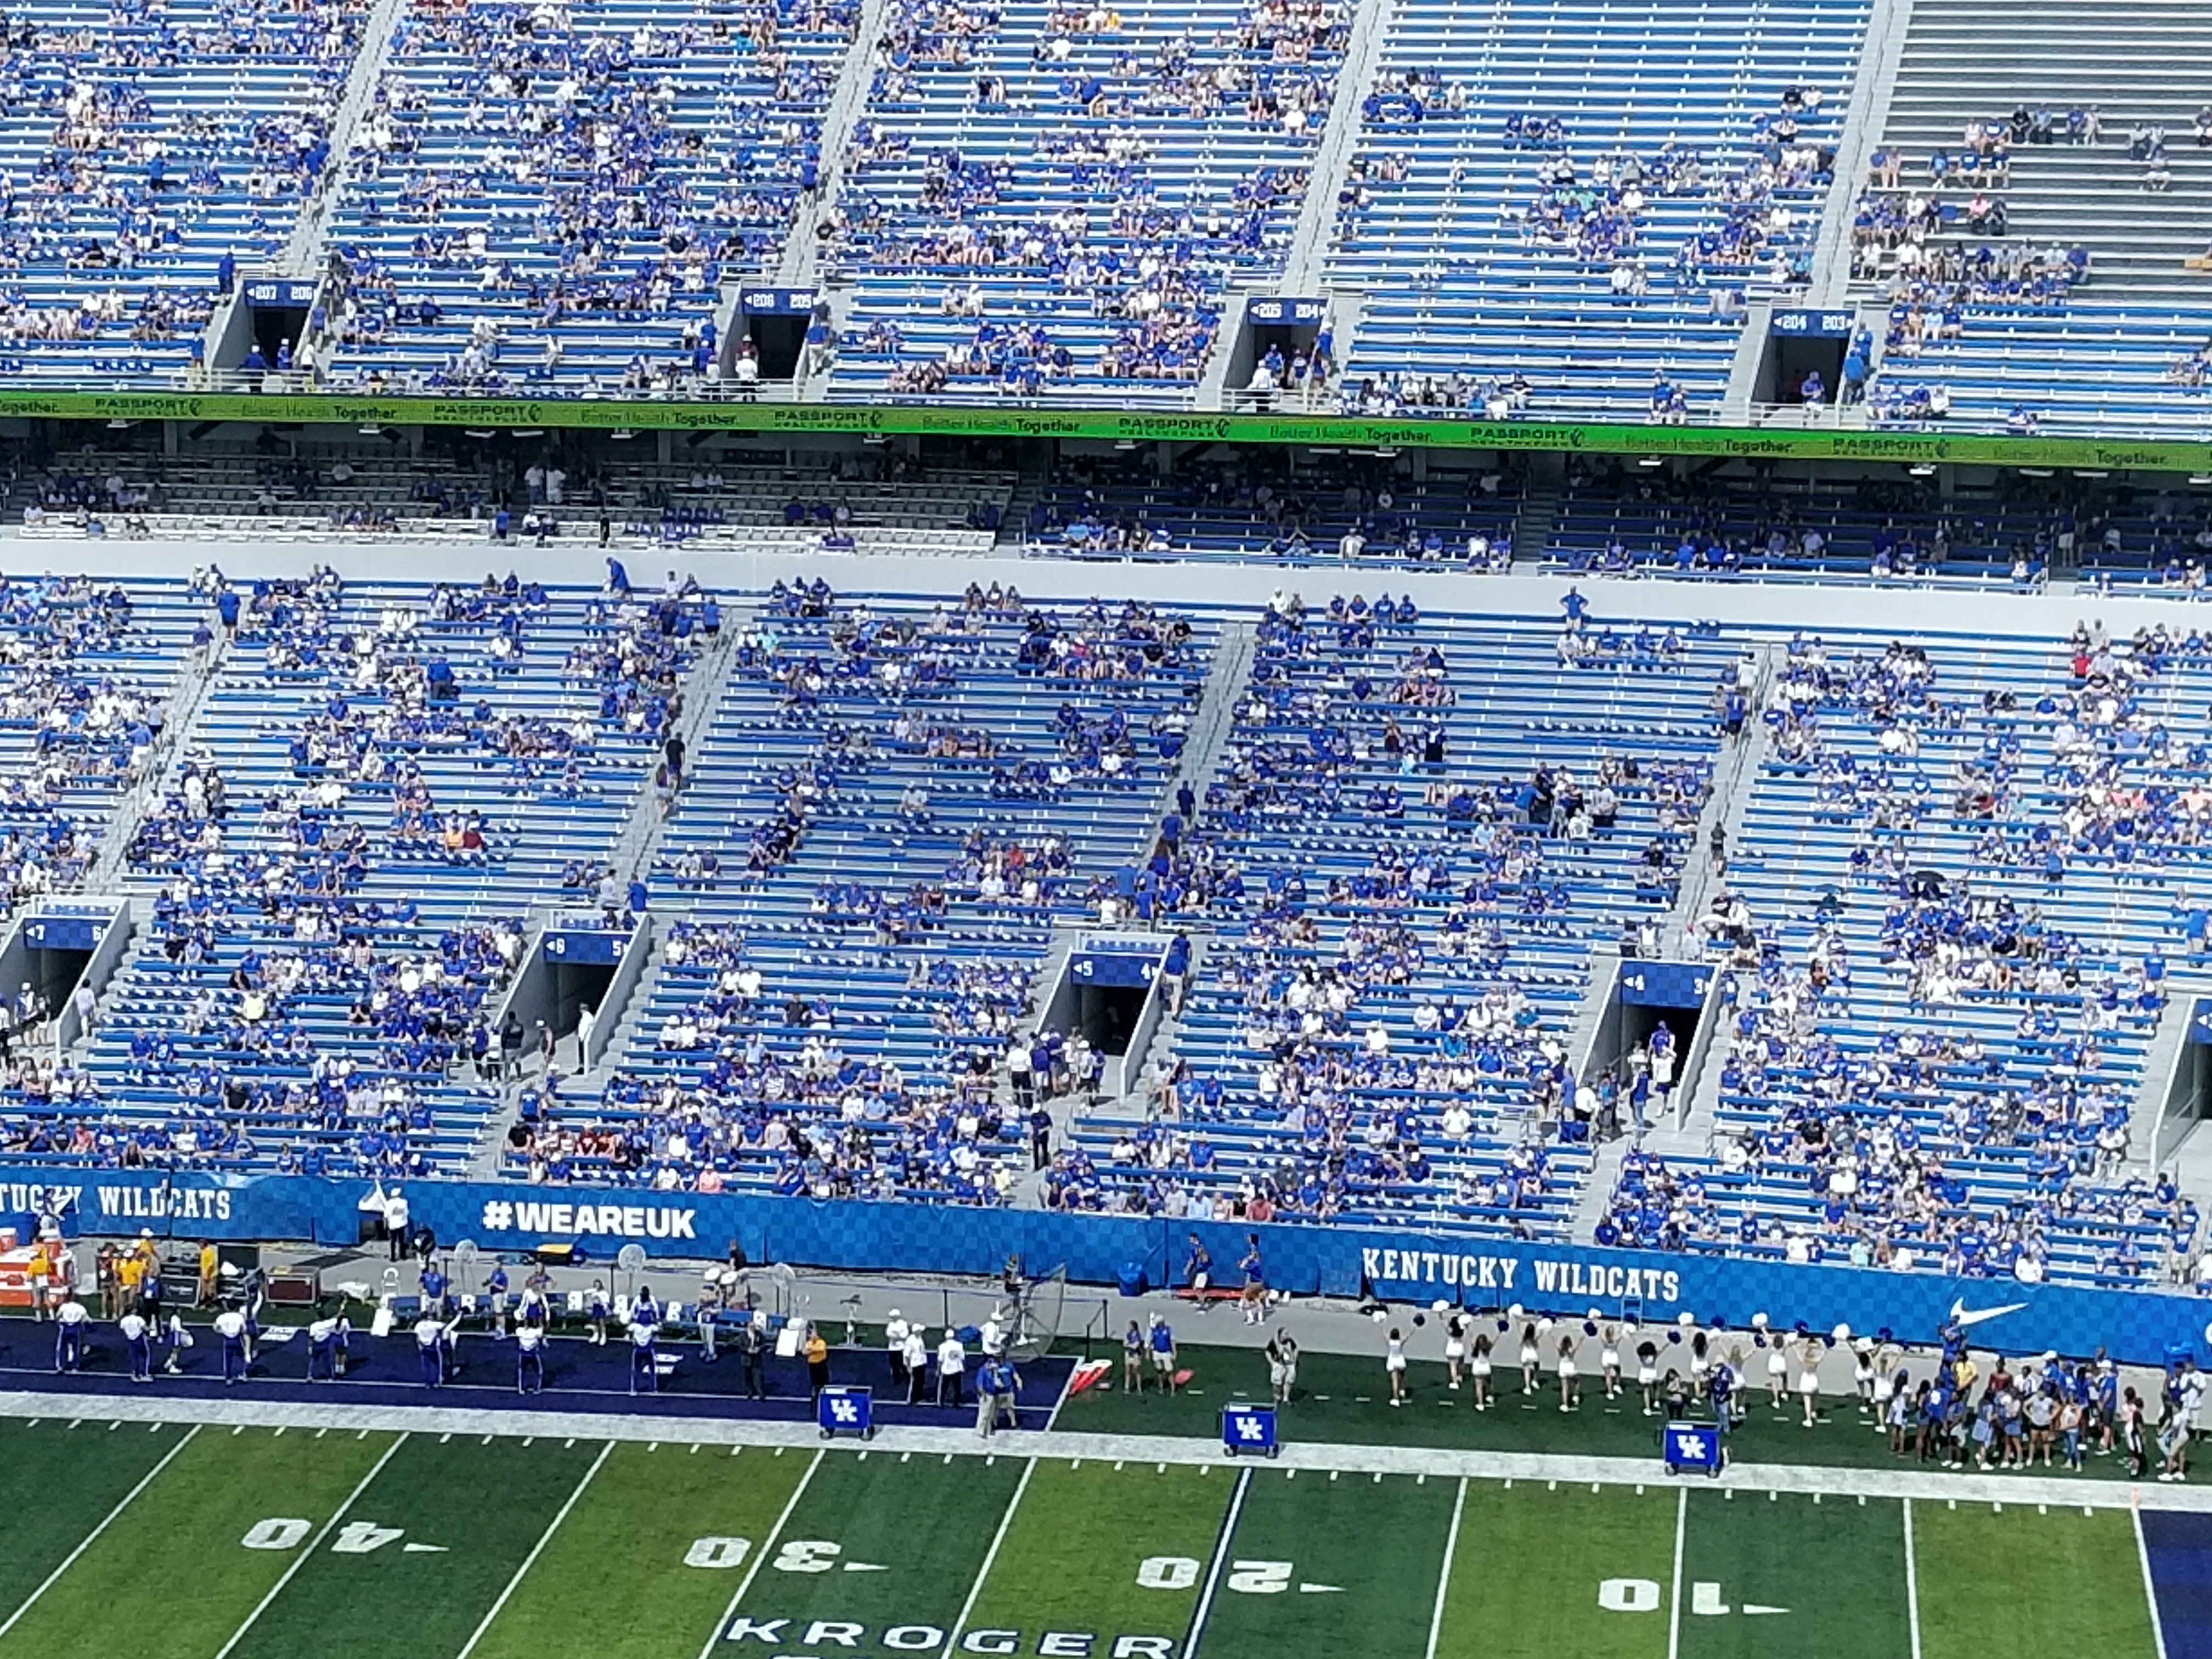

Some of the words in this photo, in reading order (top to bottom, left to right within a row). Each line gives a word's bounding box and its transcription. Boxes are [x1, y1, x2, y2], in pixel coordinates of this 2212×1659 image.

[255, 285, 277, 300] 207
[1782, 315, 1807, 330] 204
[1822, 315, 1845, 330] 203
[775, 411, 866, 421] PASSPORT
[1119, 418, 1214, 430] PASSPORT
[1470, 427, 1569, 439] PASSPORT
[1833, 438, 1933, 450] PASSPORT
[36, 924, 45, 940] 7
[612, 940, 622, 956] 5
[1083, 961, 1092, 976] 5
[1141, 962, 1150, 979] 4
[1634, 974, 1645, 991] 4
[1694, 978, 1702, 995] 3
[0, 1183, 82, 1215] TUCY
[98, 1186, 232, 1219] WILDCATS
[482, 1200, 696, 1239] #WEAREUK
[1362, 1247, 1518, 1289] KENTUCKY
[1534, 1260, 1679, 1301] WILDCATS
[830, 1399, 858, 1422] UK
[1234, 1417, 1263, 1440] UK
[1677, 1435, 1706, 1460] UK
[726, 1618, 1177, 1659] KROGER
